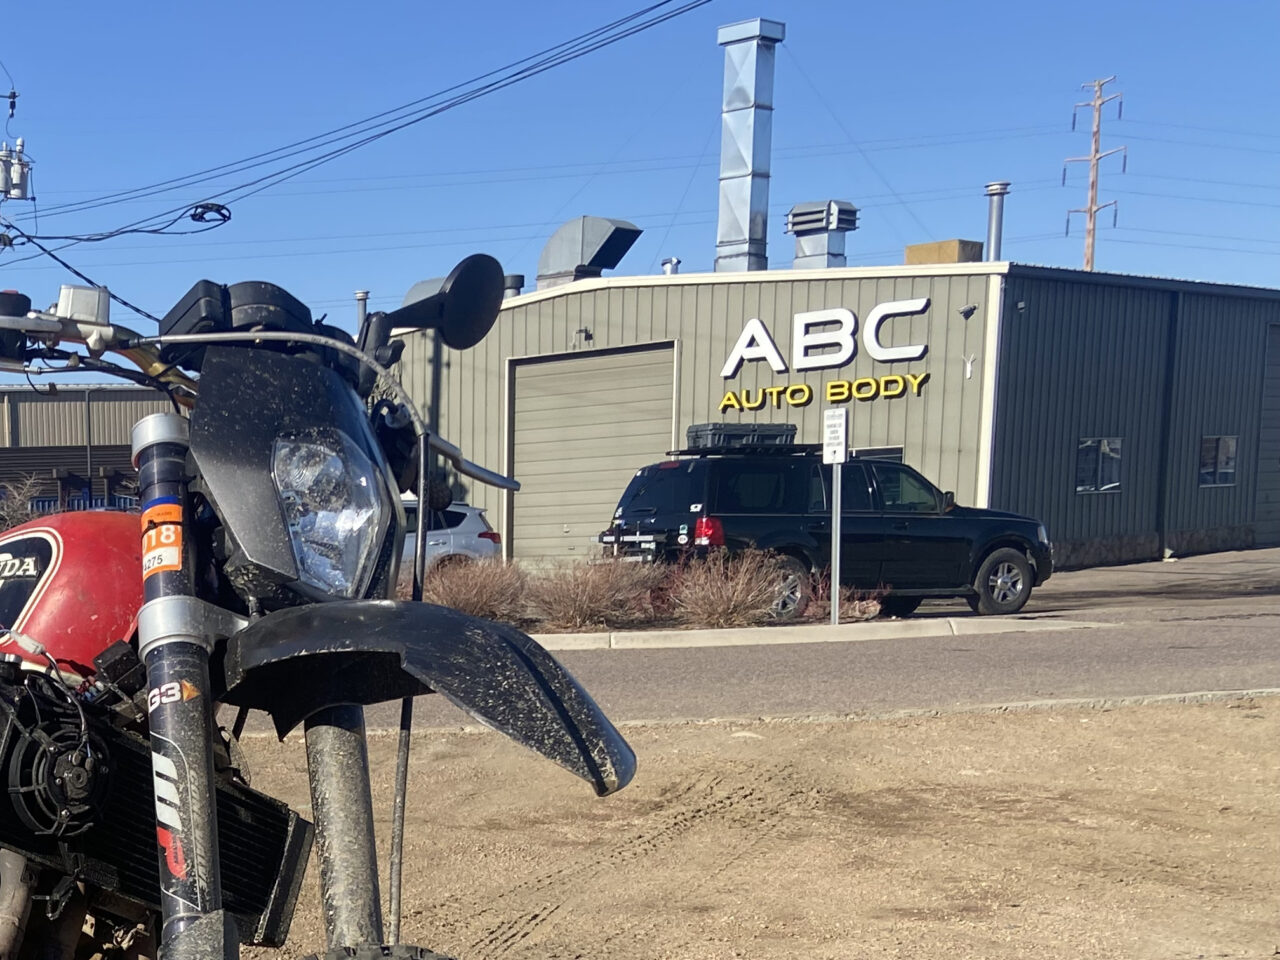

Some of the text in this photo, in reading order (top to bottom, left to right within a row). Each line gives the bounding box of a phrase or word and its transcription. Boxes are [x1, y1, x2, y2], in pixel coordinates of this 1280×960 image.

[719, 297, 929, 377] ABC
[718, 373, 927, 410] AUTO BODY
[147, 681, 182, 714] G3
